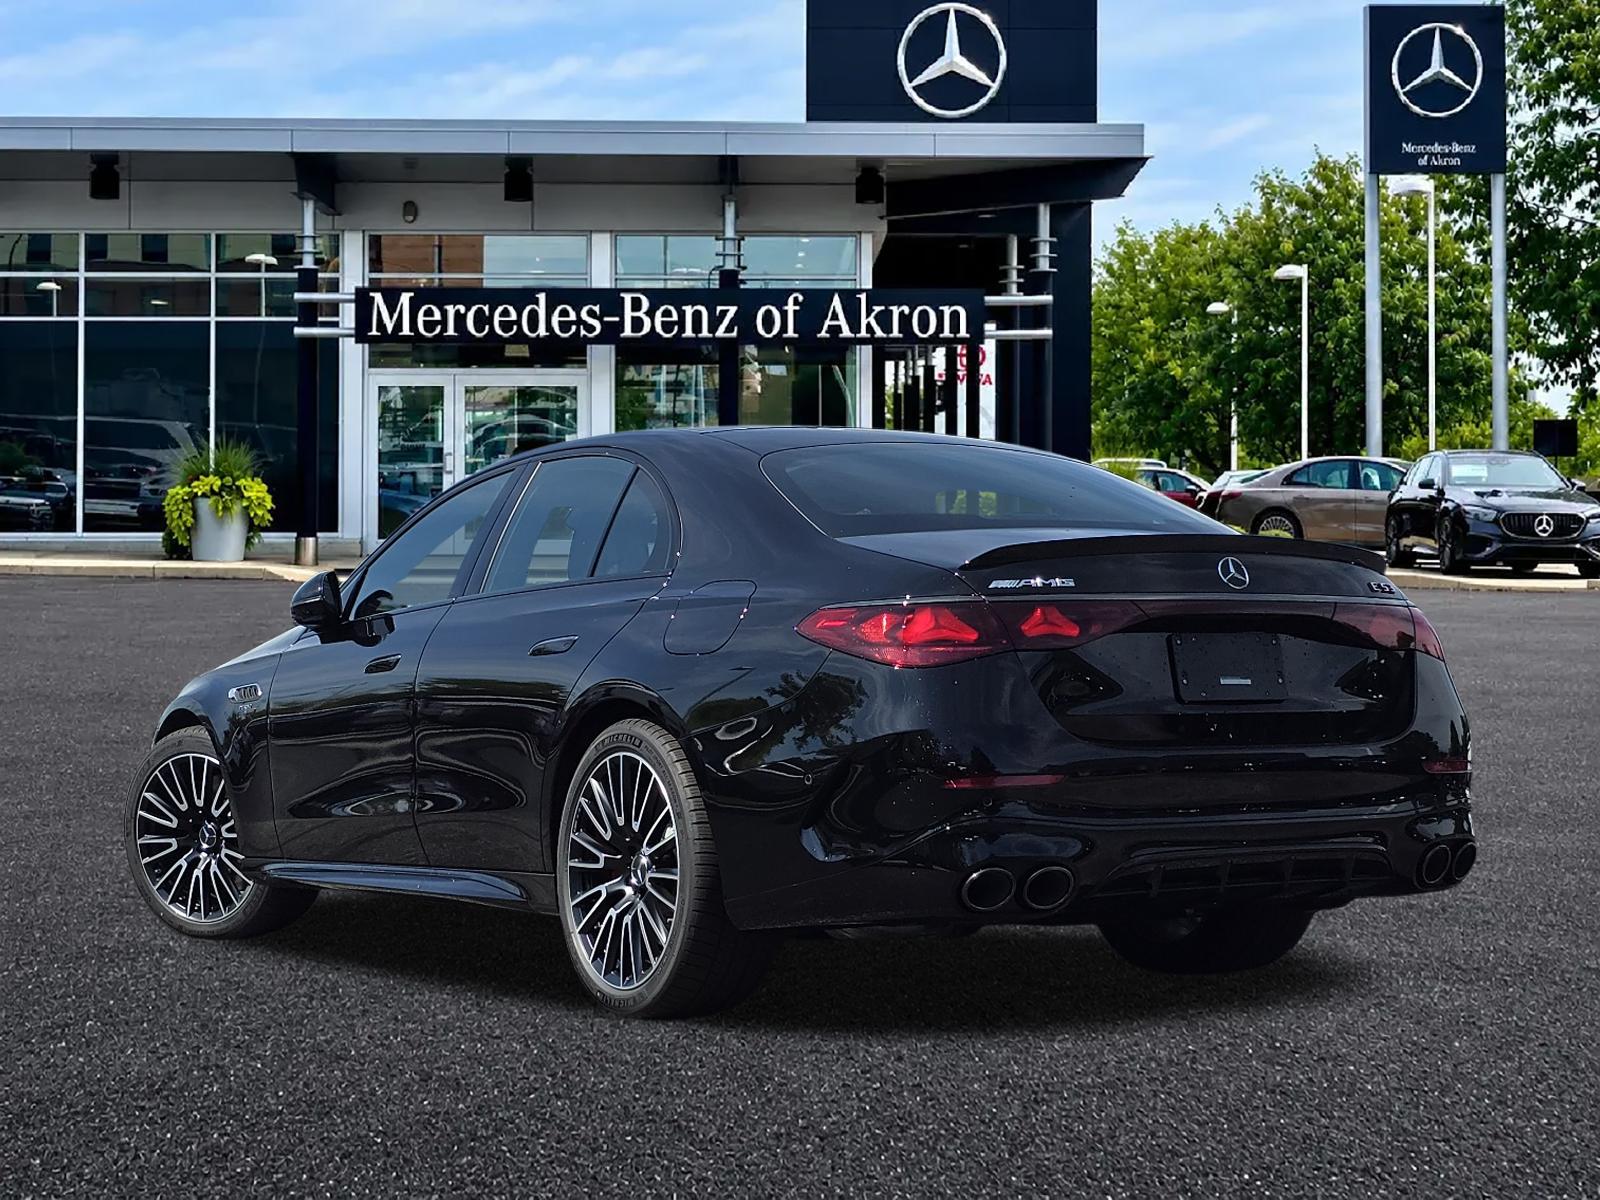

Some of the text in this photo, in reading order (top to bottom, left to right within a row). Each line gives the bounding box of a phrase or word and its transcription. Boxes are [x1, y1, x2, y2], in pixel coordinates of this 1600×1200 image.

[1401, 141, 1476, 153] Mercedes-Benz
[1417, 154, 1461, 166] of Akron
[367, 292, 969, 337] Mercedes-Benz of Akron
